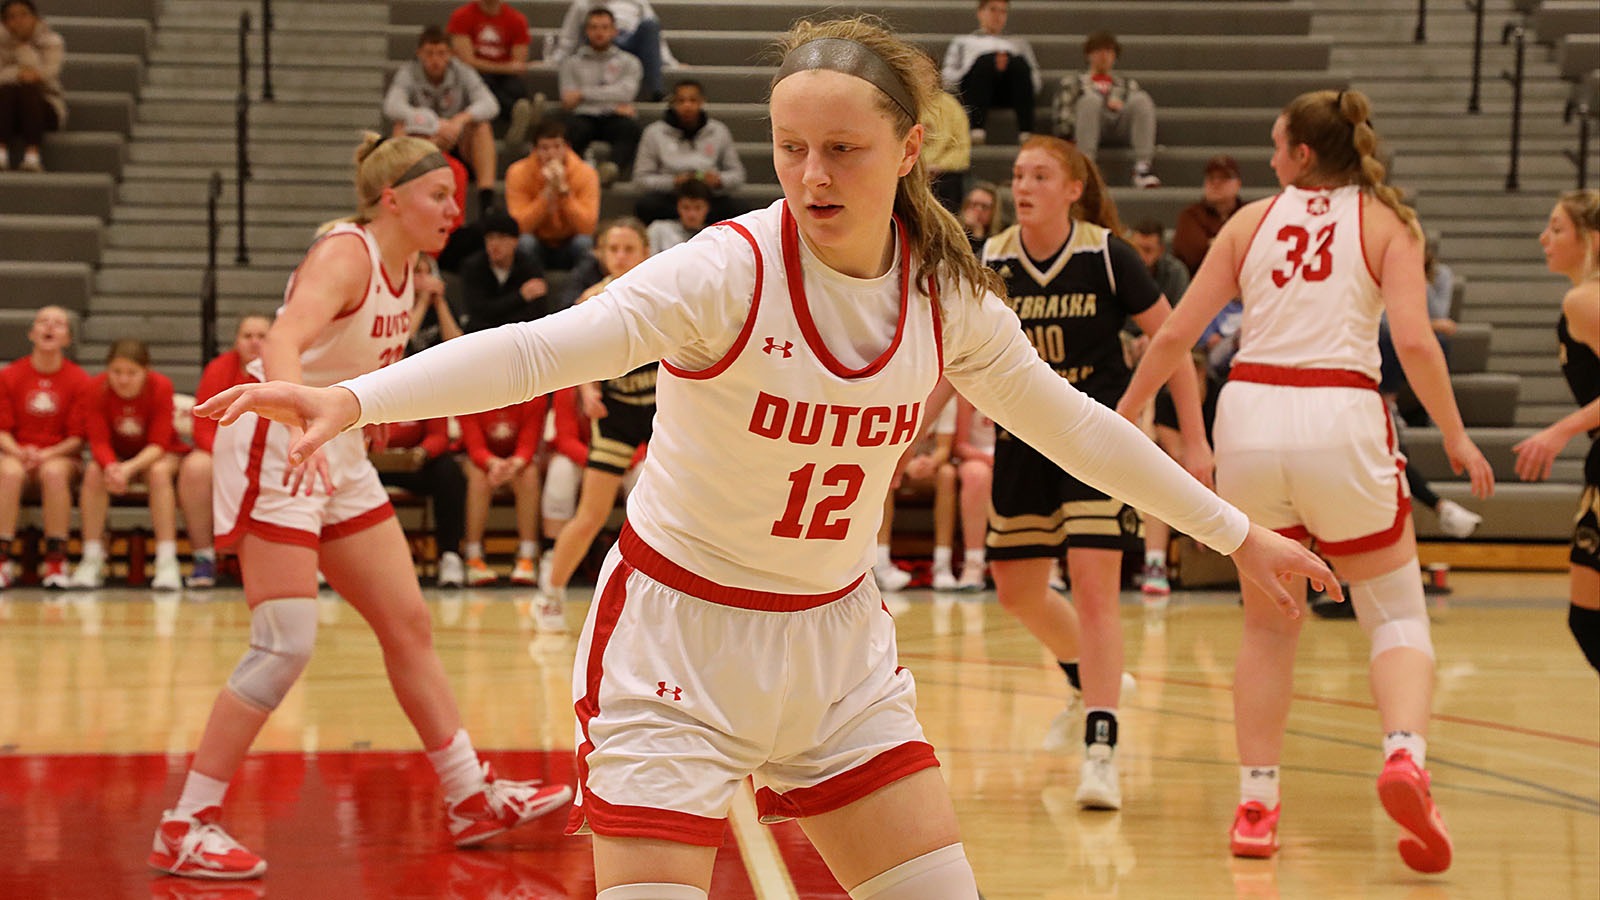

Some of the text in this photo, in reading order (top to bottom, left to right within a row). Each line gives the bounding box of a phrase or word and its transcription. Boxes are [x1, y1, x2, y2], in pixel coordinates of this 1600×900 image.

[1272, 222, 1337, 289] 33
[370, 310, 409, 338] DUTC
[1007, 293, 1097, 319] EBRASKA
[748, 391, 920, 447] DUTCH
[770, 463, 866, 540] 12
